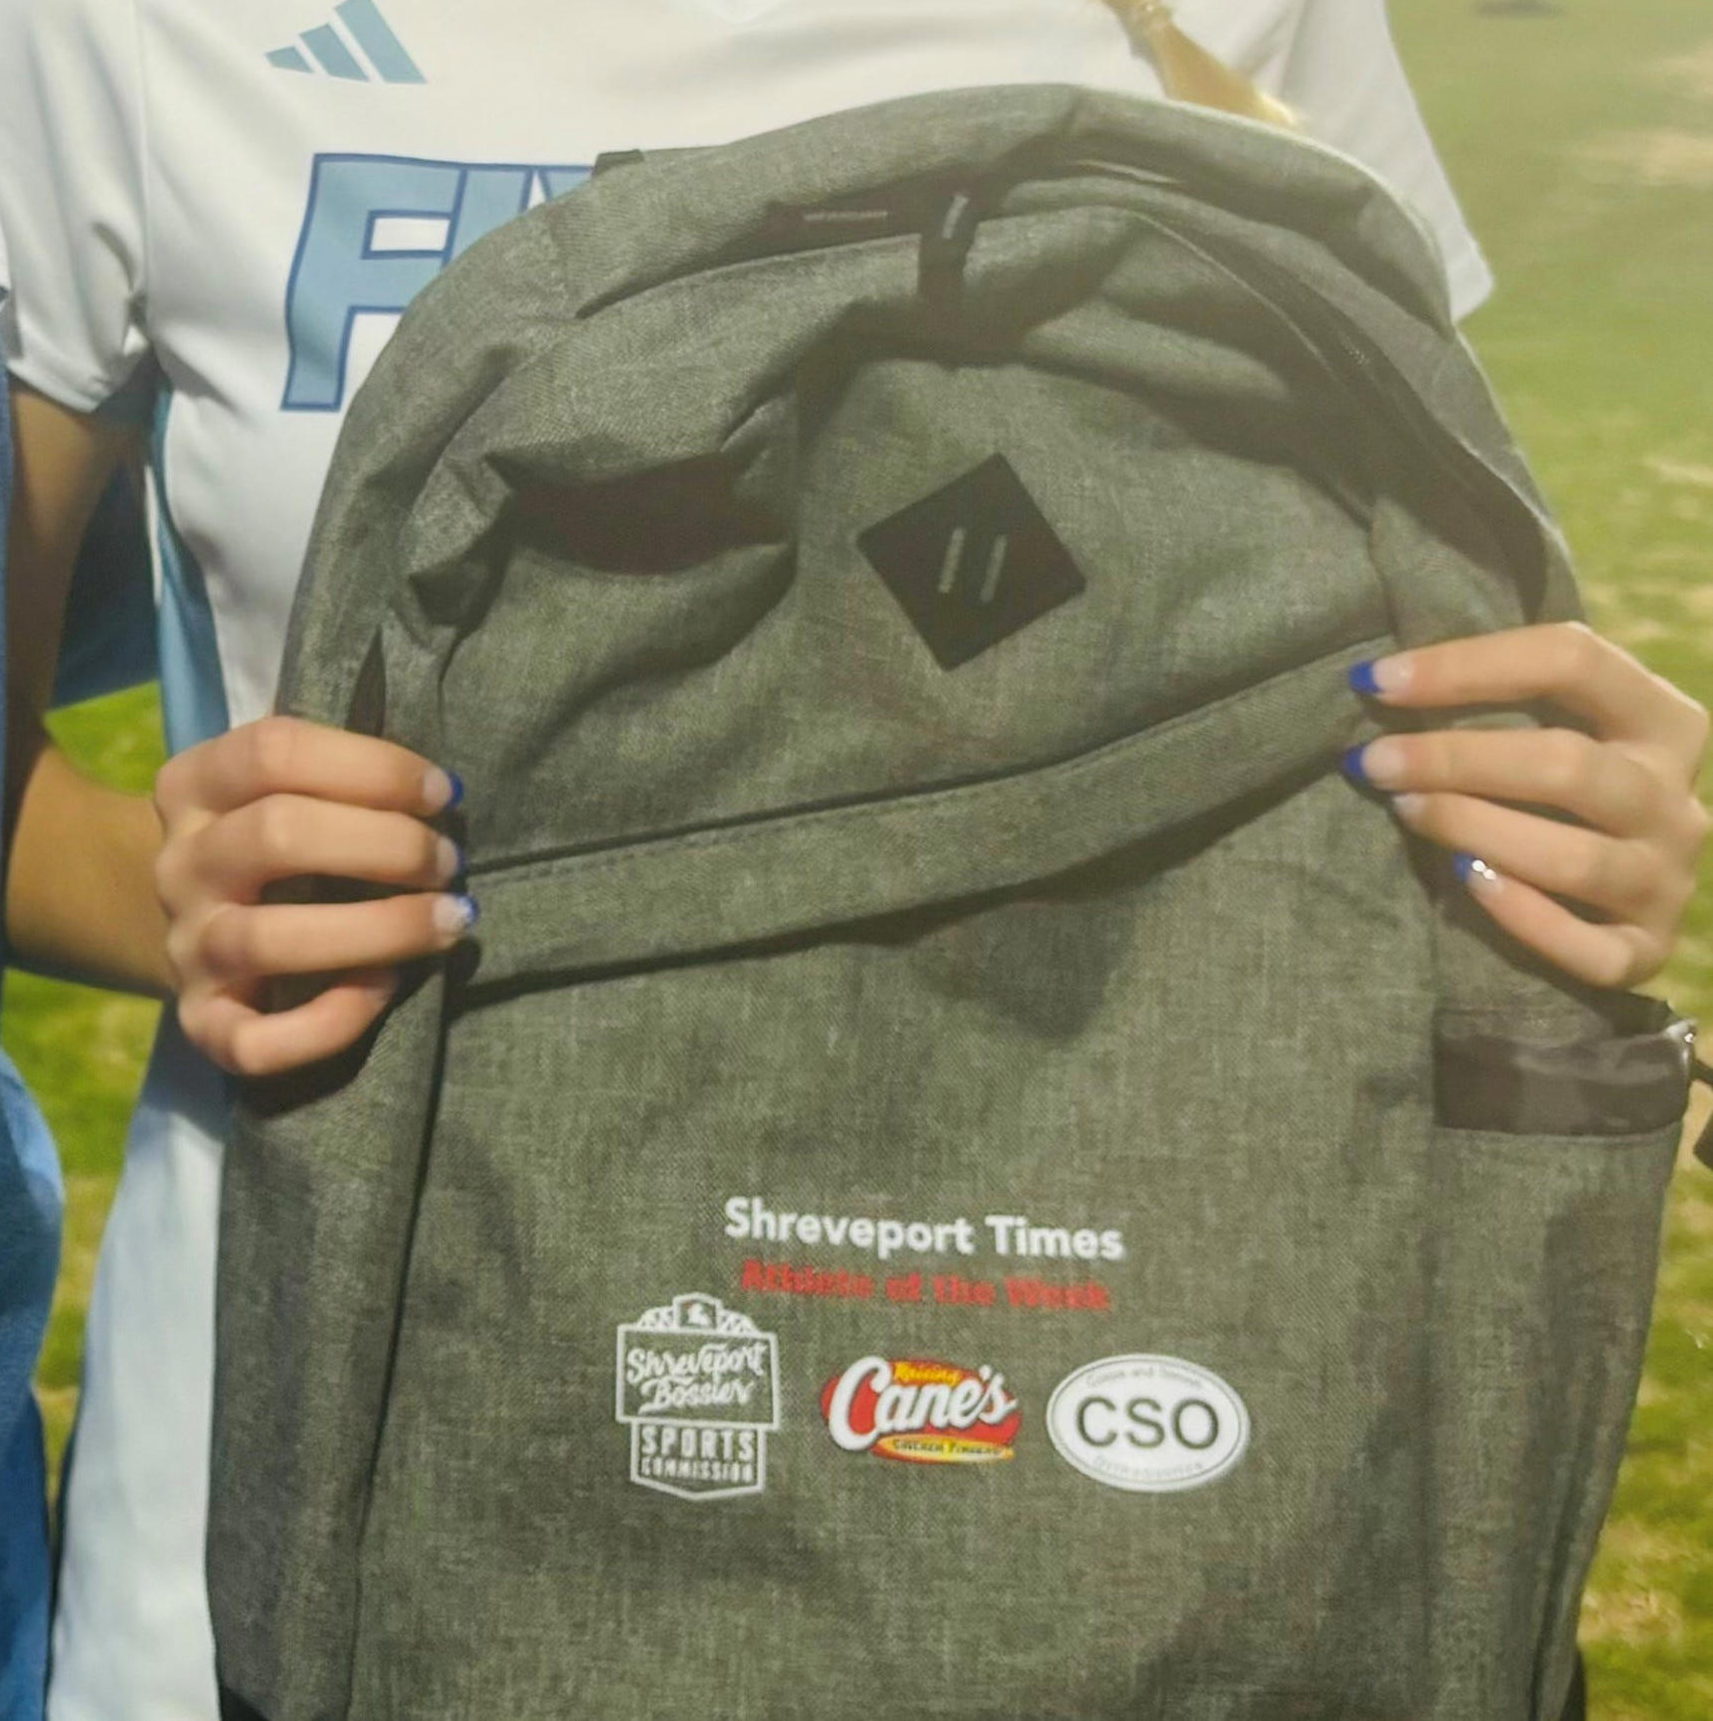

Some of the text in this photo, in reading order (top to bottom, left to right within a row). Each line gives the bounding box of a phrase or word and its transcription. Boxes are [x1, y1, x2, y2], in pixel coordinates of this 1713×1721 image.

[724, 1196, 1127, 1260] Shreveport Times
[934, 1274, 996, 1306] the
[626, 1341, 768, 1385] Shreveport
[829, 1355, 1019, 1452] Cane's
[1076, 1395, 1220, 1450] CSO
[641, 1426, 756, 1462] SPORTS
